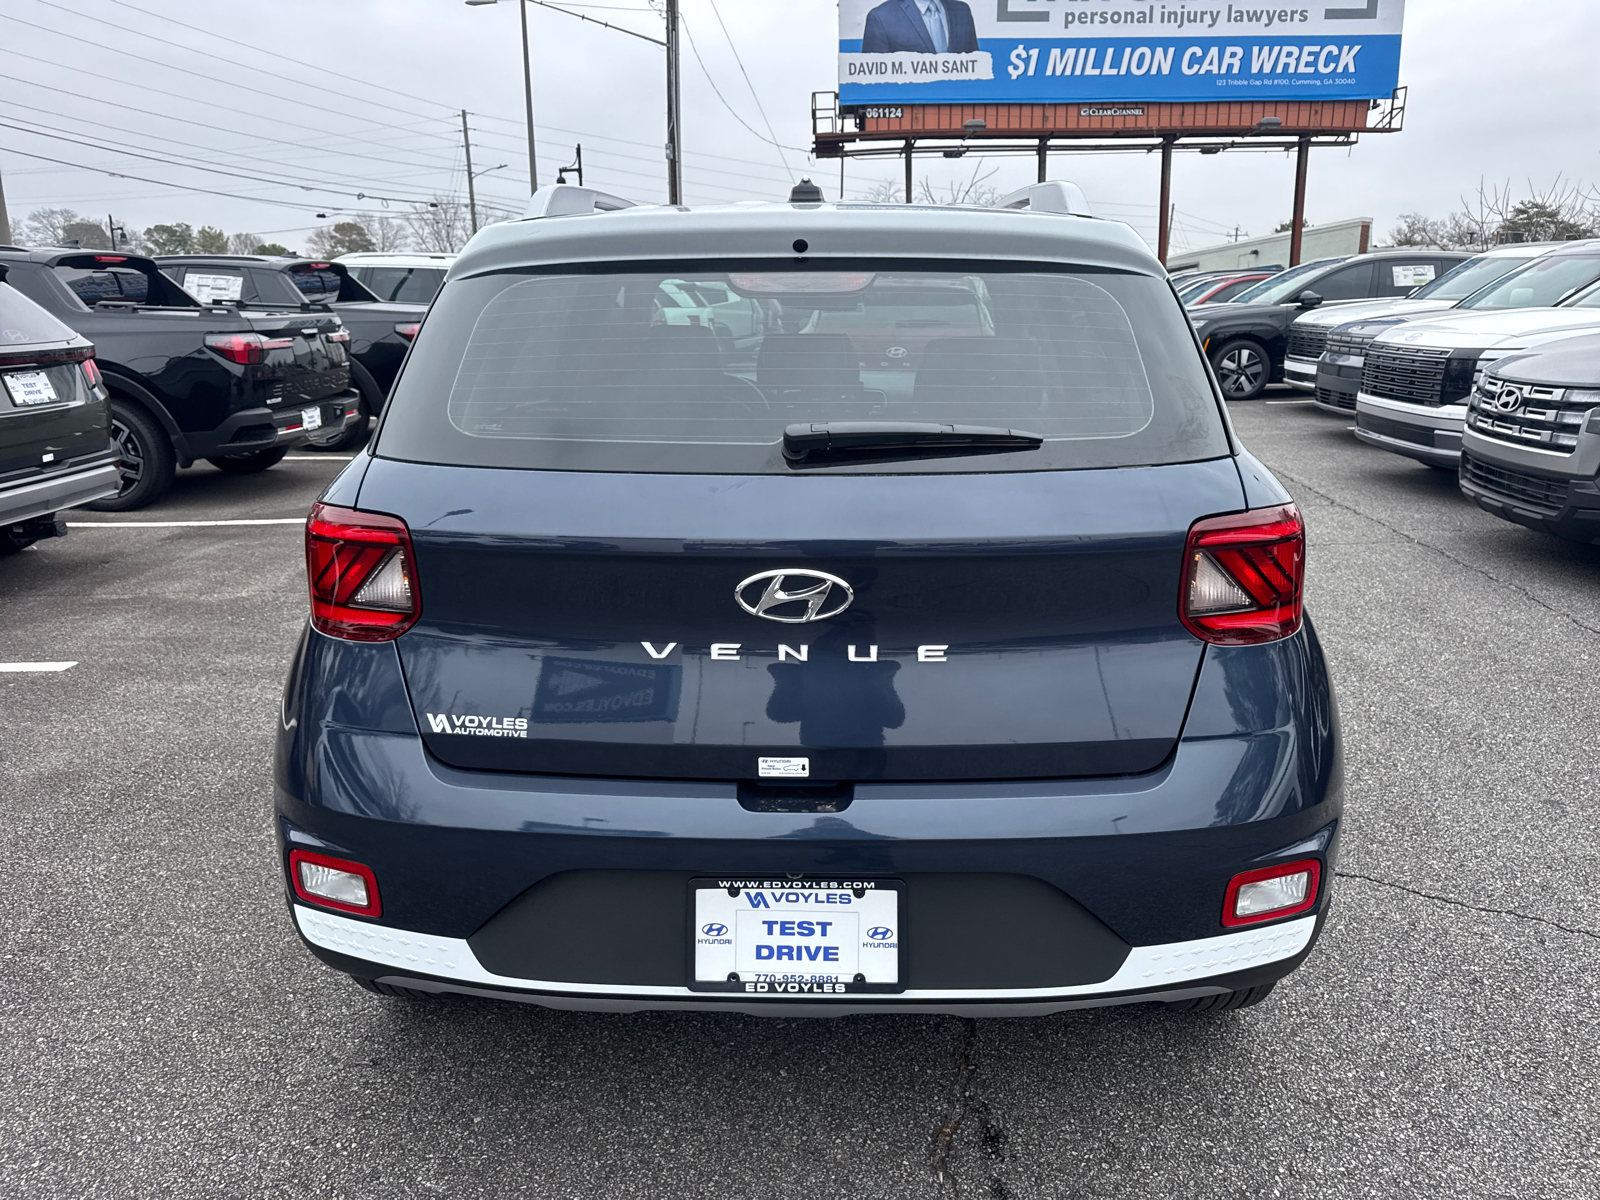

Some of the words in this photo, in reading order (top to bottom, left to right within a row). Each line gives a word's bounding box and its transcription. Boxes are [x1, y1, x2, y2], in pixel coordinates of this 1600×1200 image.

[1064, 5, 1154, 29] personal
[1160, 5, 1221, 29] injury
[1227, 4, 1309, 27] lawyers
[848, 61, 888, 76] DAVID
[891, 61, 907, 75] M.
[911, 60, 938, 75] VAN
[942, 60, 978, 74] SANT
[1007, 44, 1040, 80] $1
[1045, 47, 1176, 76] MILLION
[1181, 46, 1244, 75] CAR
[1251, 45, 1363, 74] WRECK
[1249, 79, 1262, 87] Gap
[1291, 78, 1322, 87] Cumming,
[866, 107, 903, 118] 061124
[640, 641, 949, 663] VENUE
[451, 714, 528, 730] VOYLES
[453, 727, 528, 738] AUTOMOTIVE
[718, 880, 875, 889] WWW.EDVOYLES.COM
[770, 892, 852, 905] VOYLES
[761, 920, 833, 937] TEST
[755, 944, 840, 962] DRIVE
[754, 973, 839, 983] 770-952-8881
[745, 982, 773, 993] ED
[775, 982, 846, 994] VOYLES
